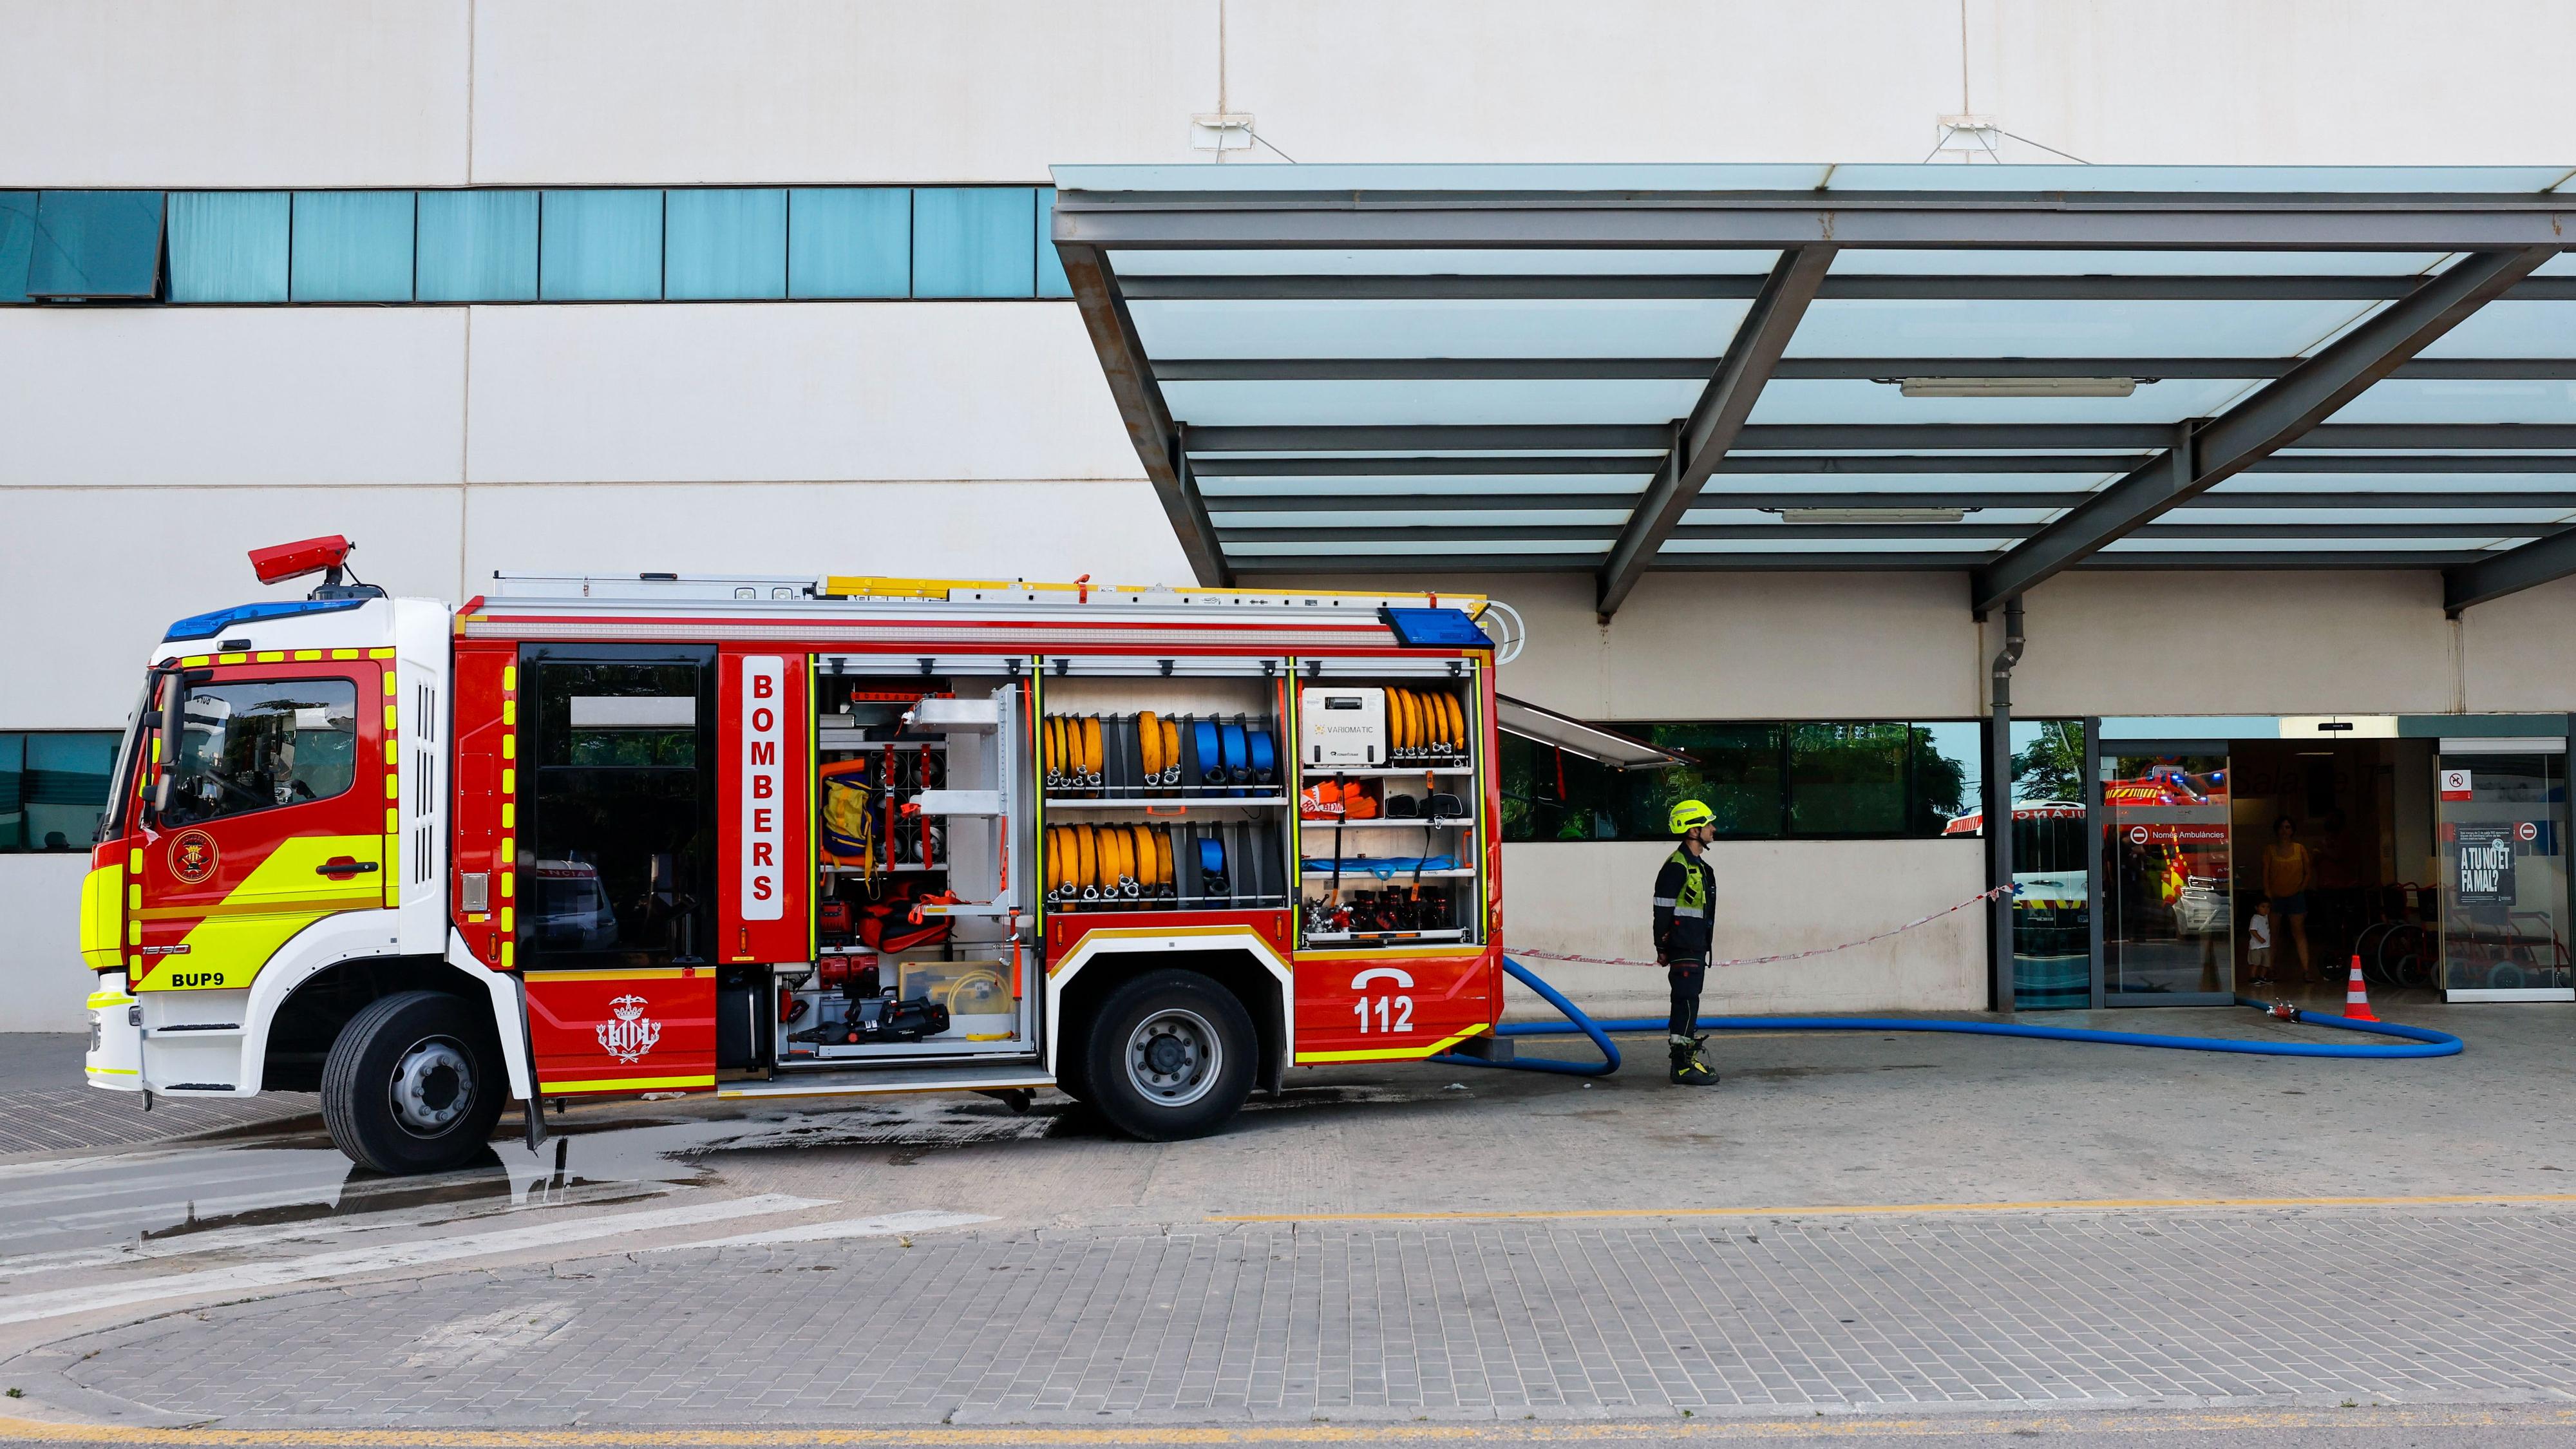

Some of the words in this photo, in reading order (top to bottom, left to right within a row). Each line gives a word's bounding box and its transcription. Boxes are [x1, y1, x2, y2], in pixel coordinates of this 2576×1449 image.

[750, 674, 775, 901] BOMBERS
[2461, 848, 2468, 869] A
[2468, 848, 2481, 869] TU
[2483, 848, 2497, 869] NO
[2498, 848, 2510, 869] ET
[2461, 870, 2473, 892] FA
[2474, 869, 2499, 892] MAL?
[142, 944, 189, 955] 1530
[172, 972, 224, 987] BUP9
[1354, 995, 1414, 1034] 112
